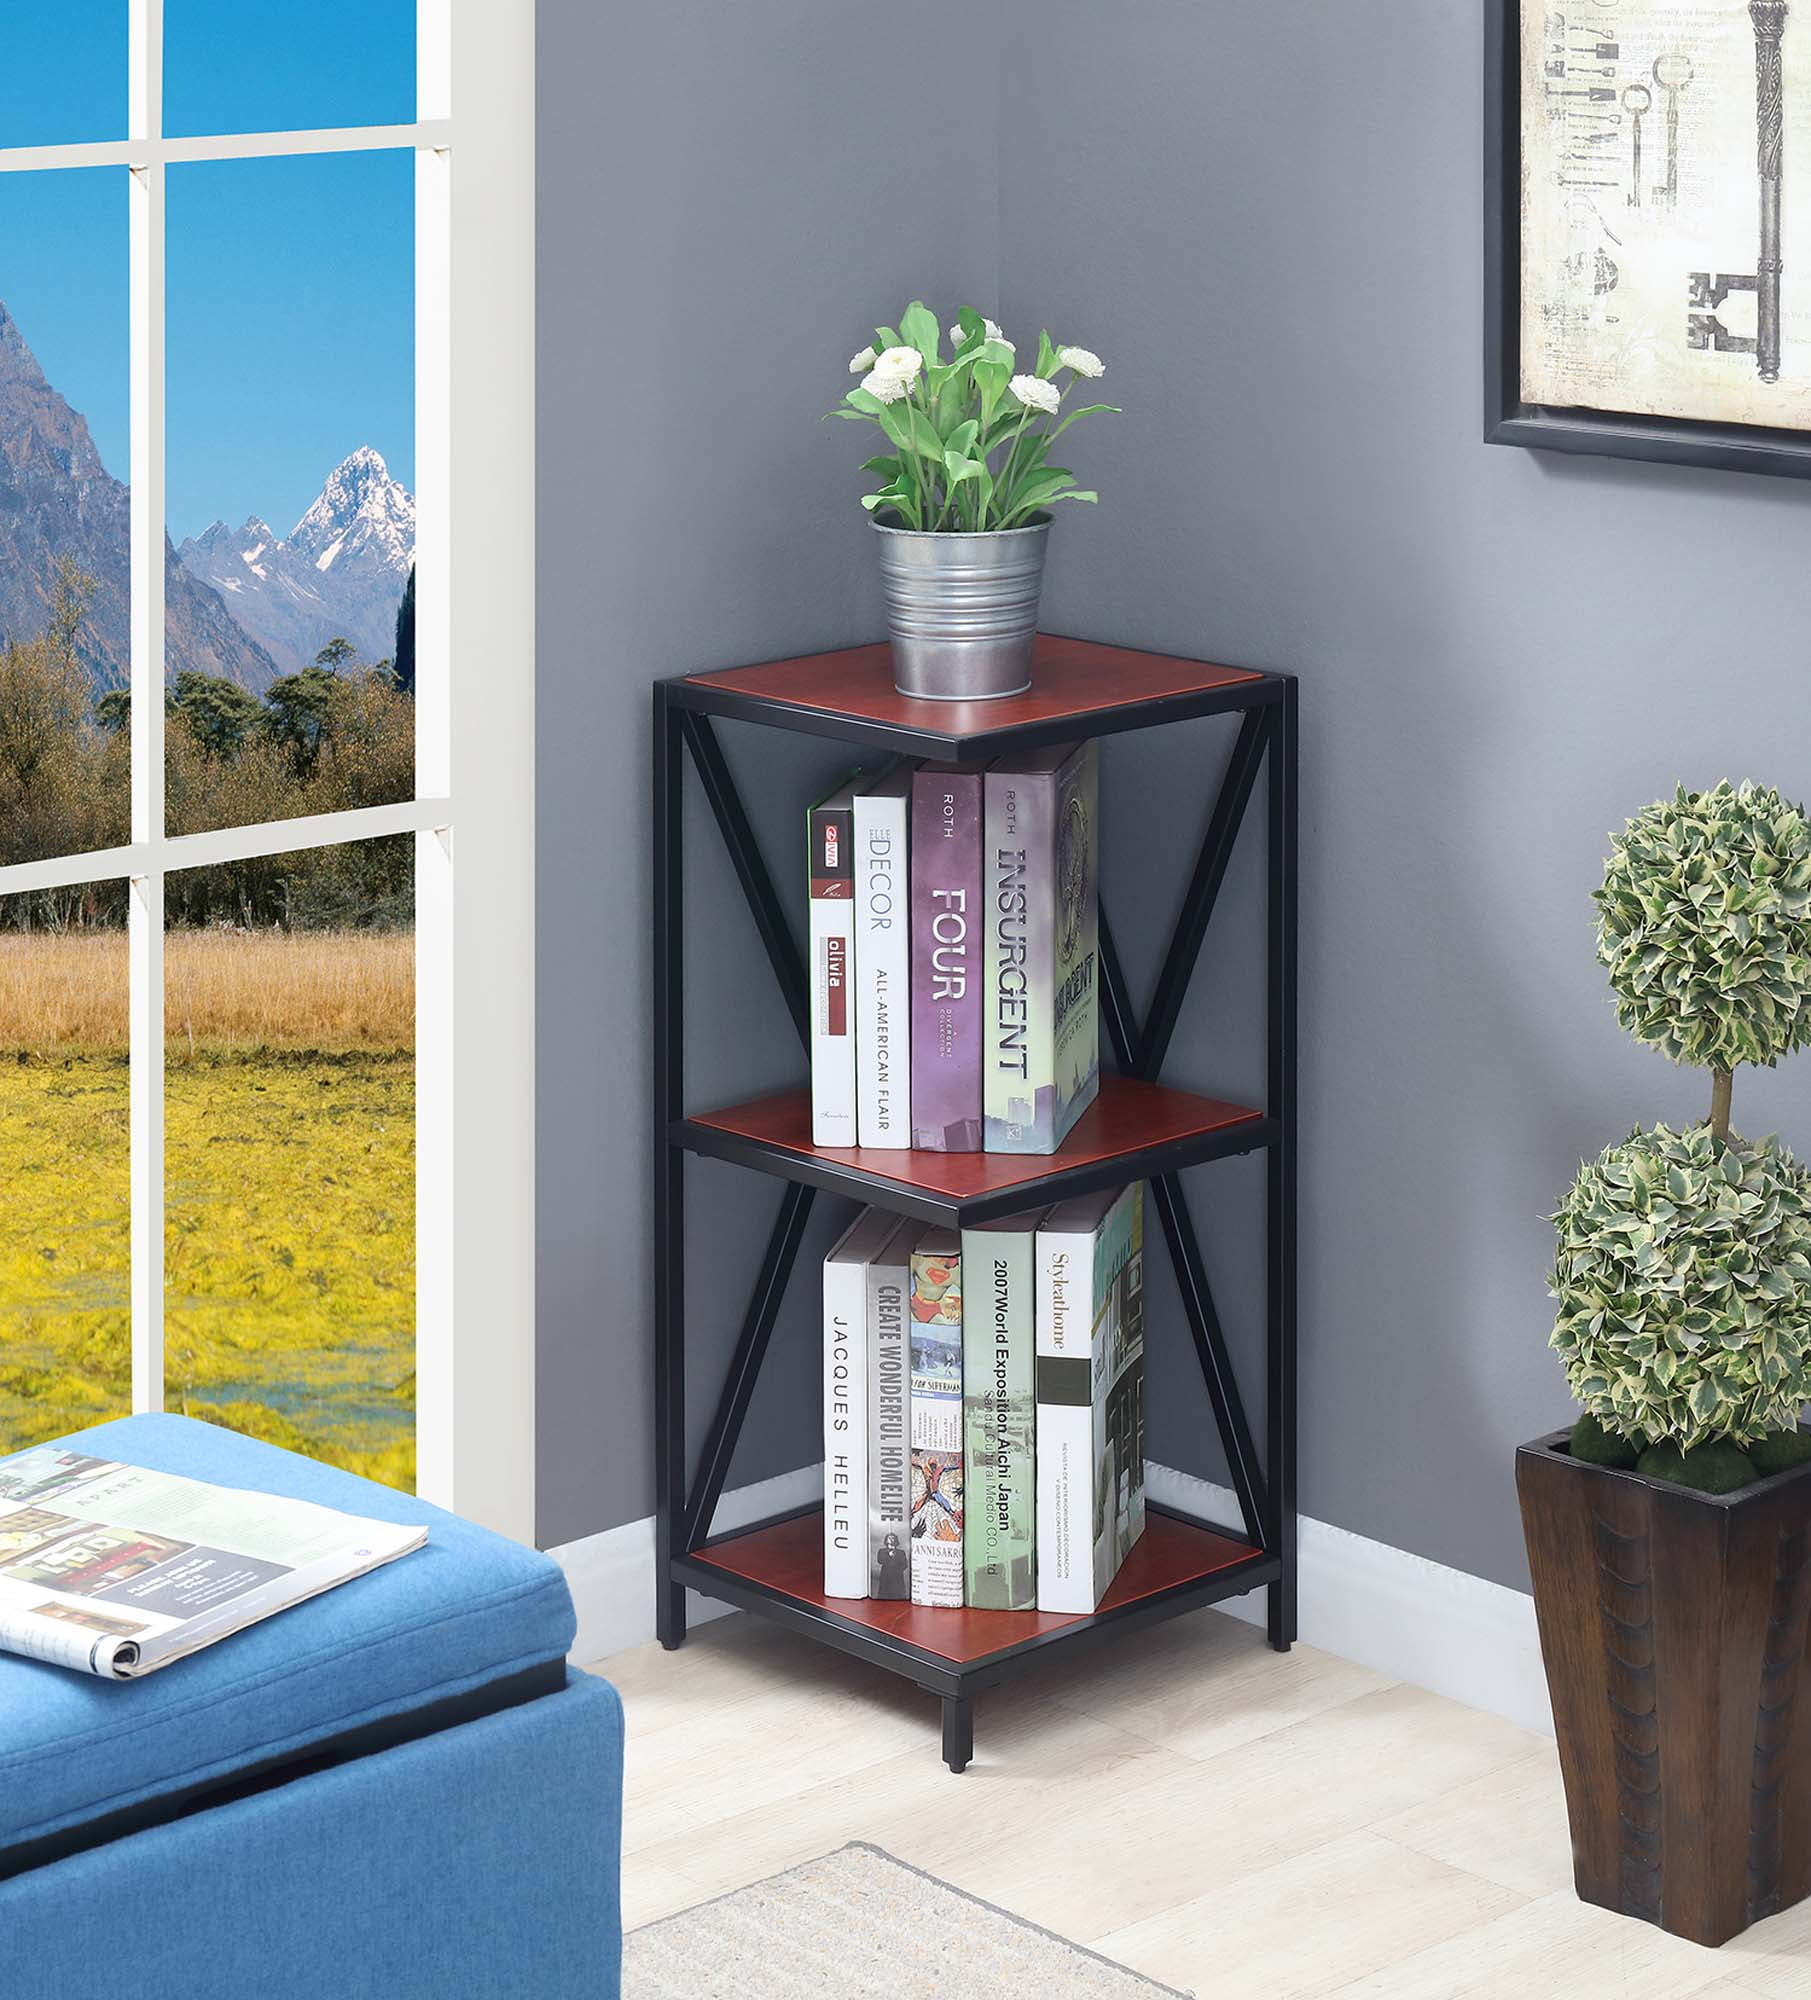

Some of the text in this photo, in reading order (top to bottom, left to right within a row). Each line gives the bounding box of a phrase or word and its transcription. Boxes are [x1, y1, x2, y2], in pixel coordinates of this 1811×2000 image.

[943, 793, 954, 839] ROTH
[1007, 790, 1016, 835] ROTH
[869, 839, 892, 931] DECOR
[829, 940, 845, 988] olivia
[931, 888, 967, 1001] FOUR
[995, 848, 1028, 1081] INSURGENT
[876, 968, 890, 1131] ALL-AMERICAN FLAIR
[1046, 1252, 1070, 1351] Styleathome
[833, 1315, 849, 1550] JACQUES HELLEU
[877, 1285, 904, 1523] CREATE WONDERFUL HOMELIFE
[927, 1381, 961, 1392] SUPERMAN
[983, 1389, 996, 1430] Sandu
[993, 1259, 1012, 1531] 2007World Exposition Aichi Japan
[984, 1433, 997, 1481] Cultural
